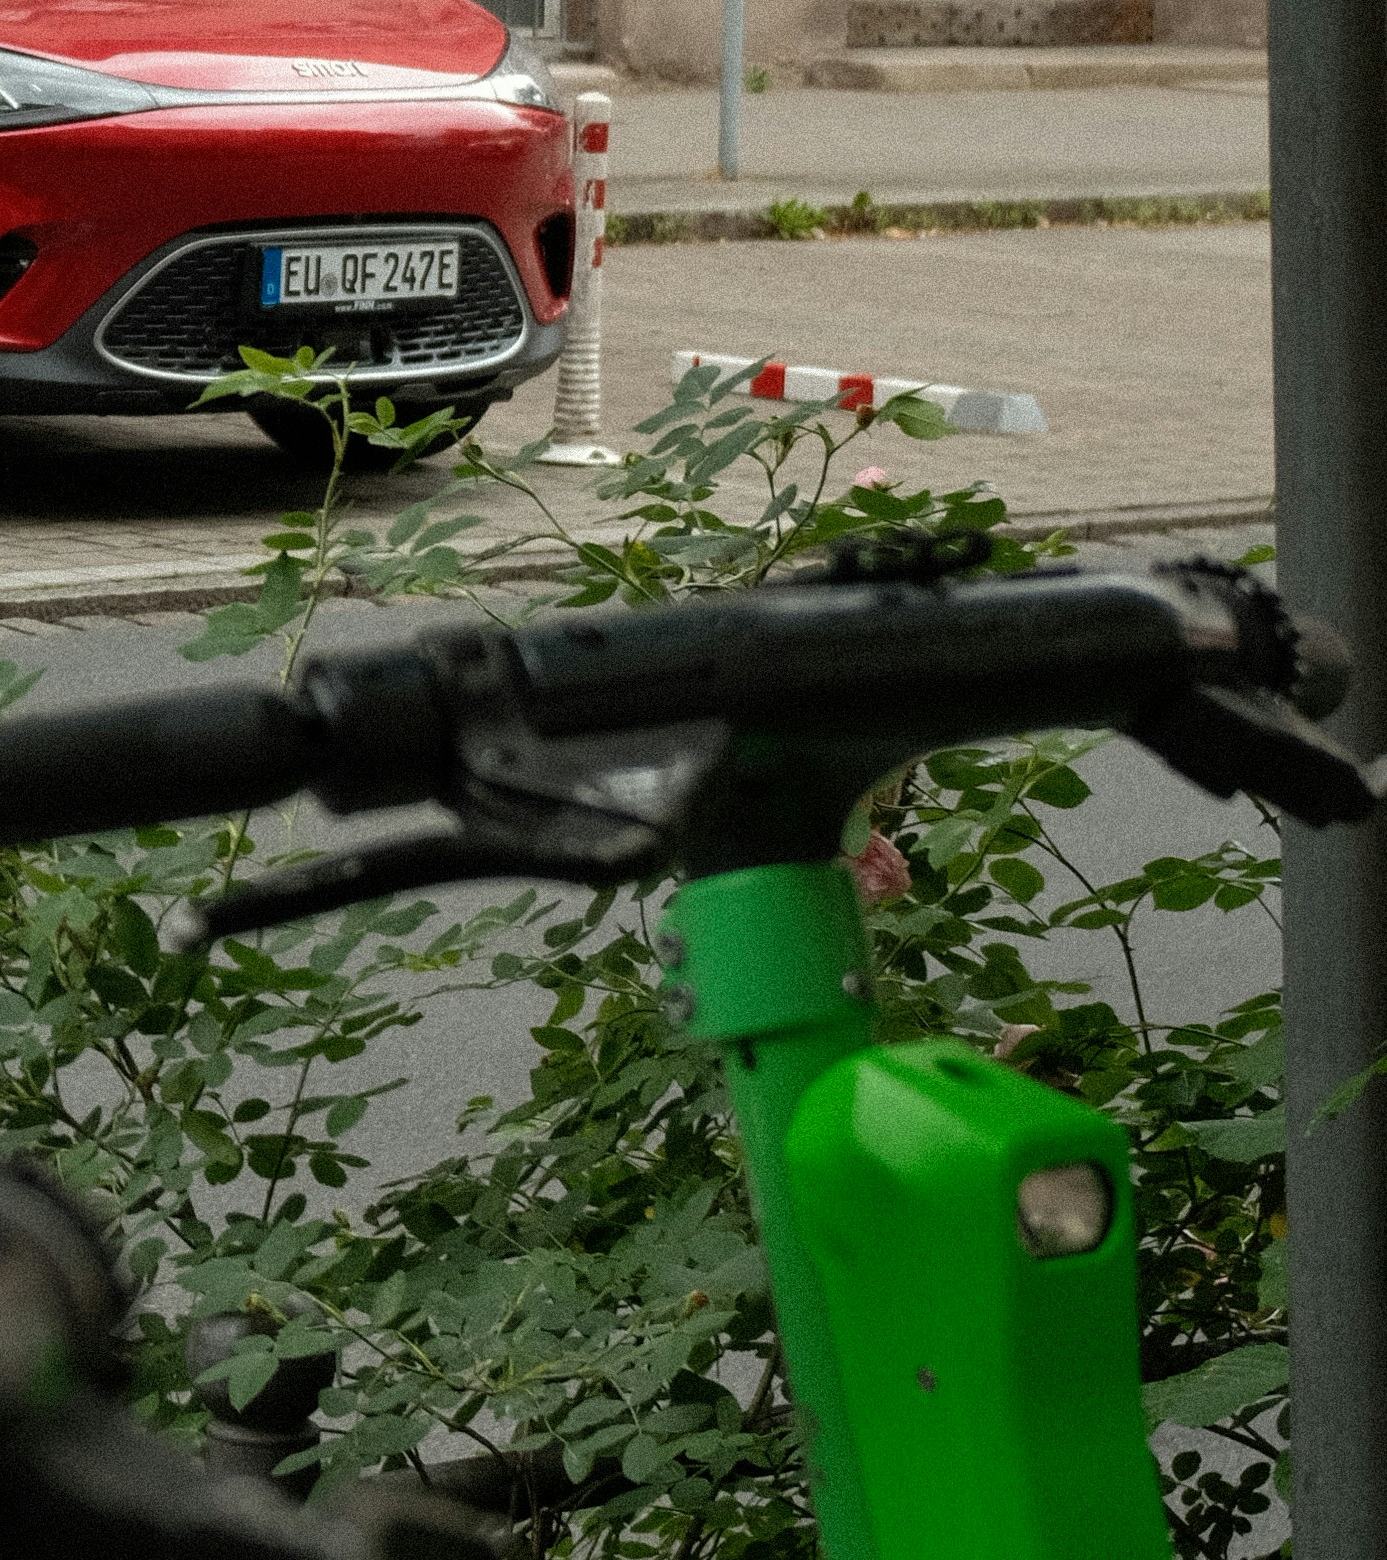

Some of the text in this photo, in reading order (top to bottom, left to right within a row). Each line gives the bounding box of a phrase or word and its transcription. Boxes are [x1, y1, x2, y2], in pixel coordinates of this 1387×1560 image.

[284, 249, 453, 297] EU QF 247E
